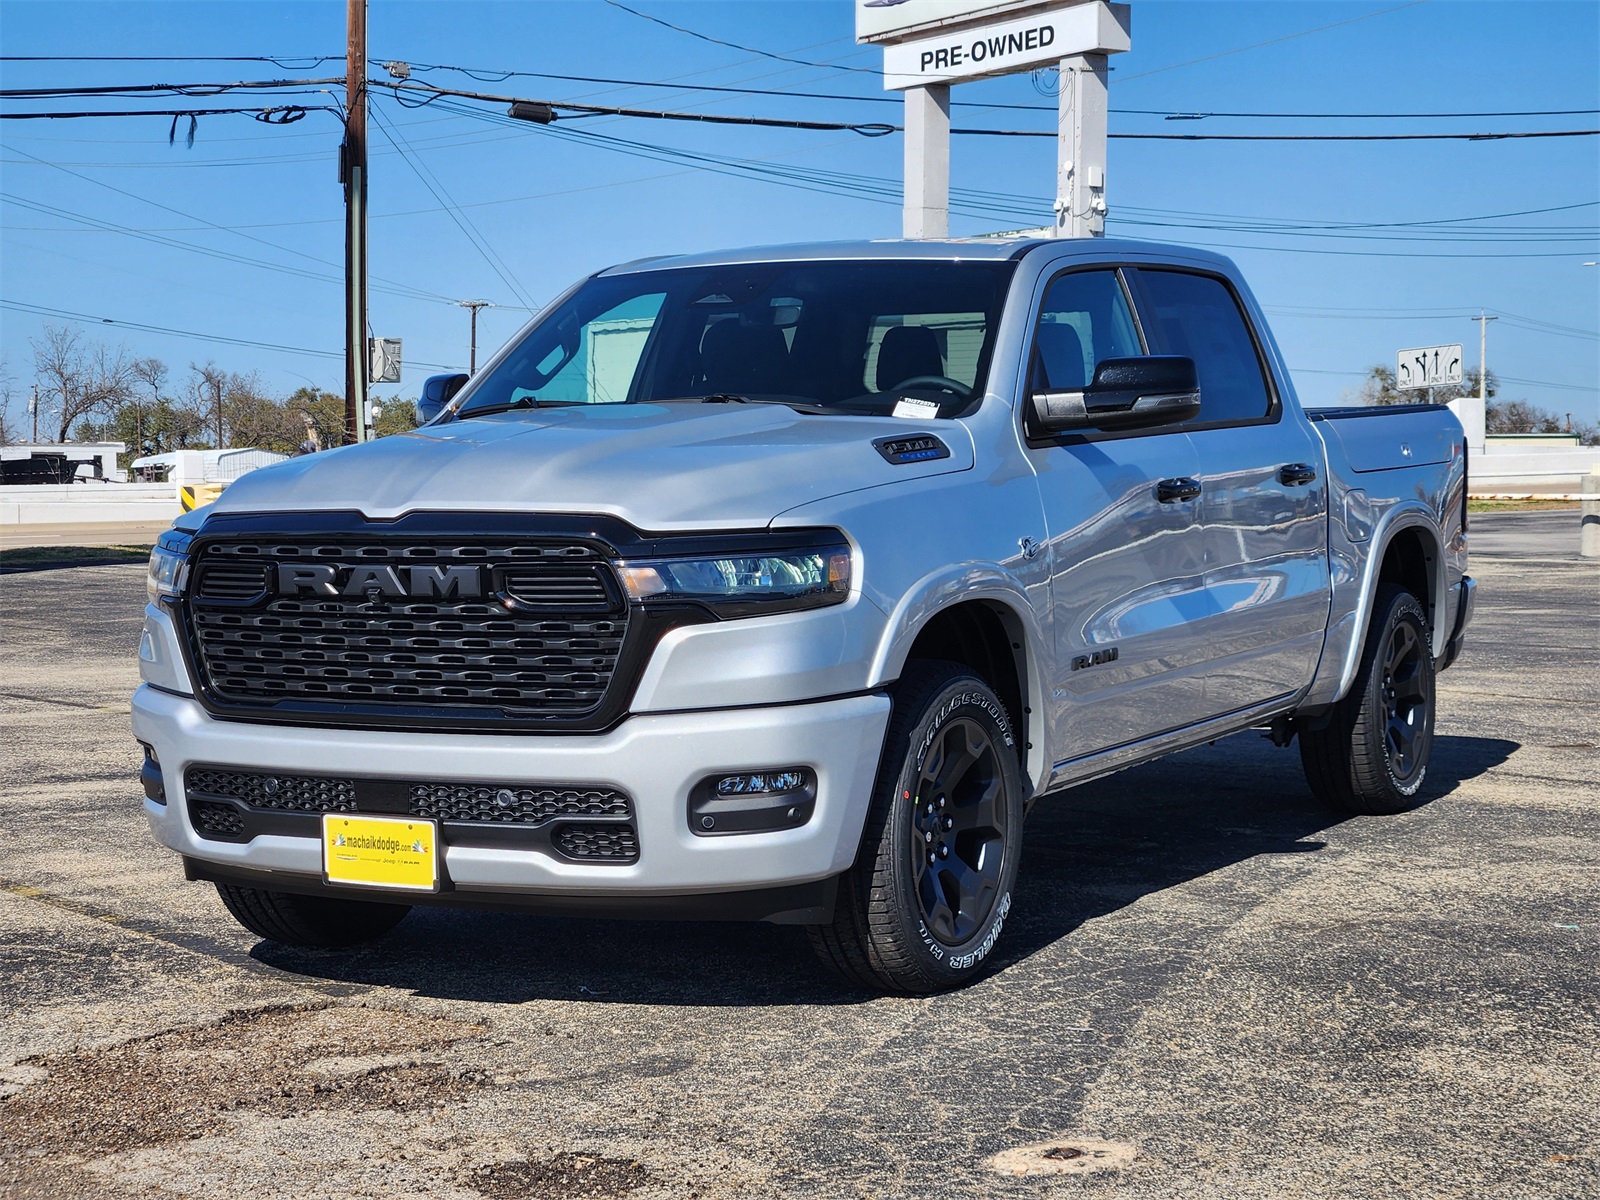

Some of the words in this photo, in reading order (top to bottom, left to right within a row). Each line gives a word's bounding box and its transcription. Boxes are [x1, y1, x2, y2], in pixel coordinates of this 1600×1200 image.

[920, 25, 1055, 72] PRE-OWNED
[278, 564, 481, 598] RAM
[1071, 647, 1119, 671] RAM
[917, 692, 1014, 772] BRIDGESTONE
[346, 835, 412, 855] machaikdodge.com
